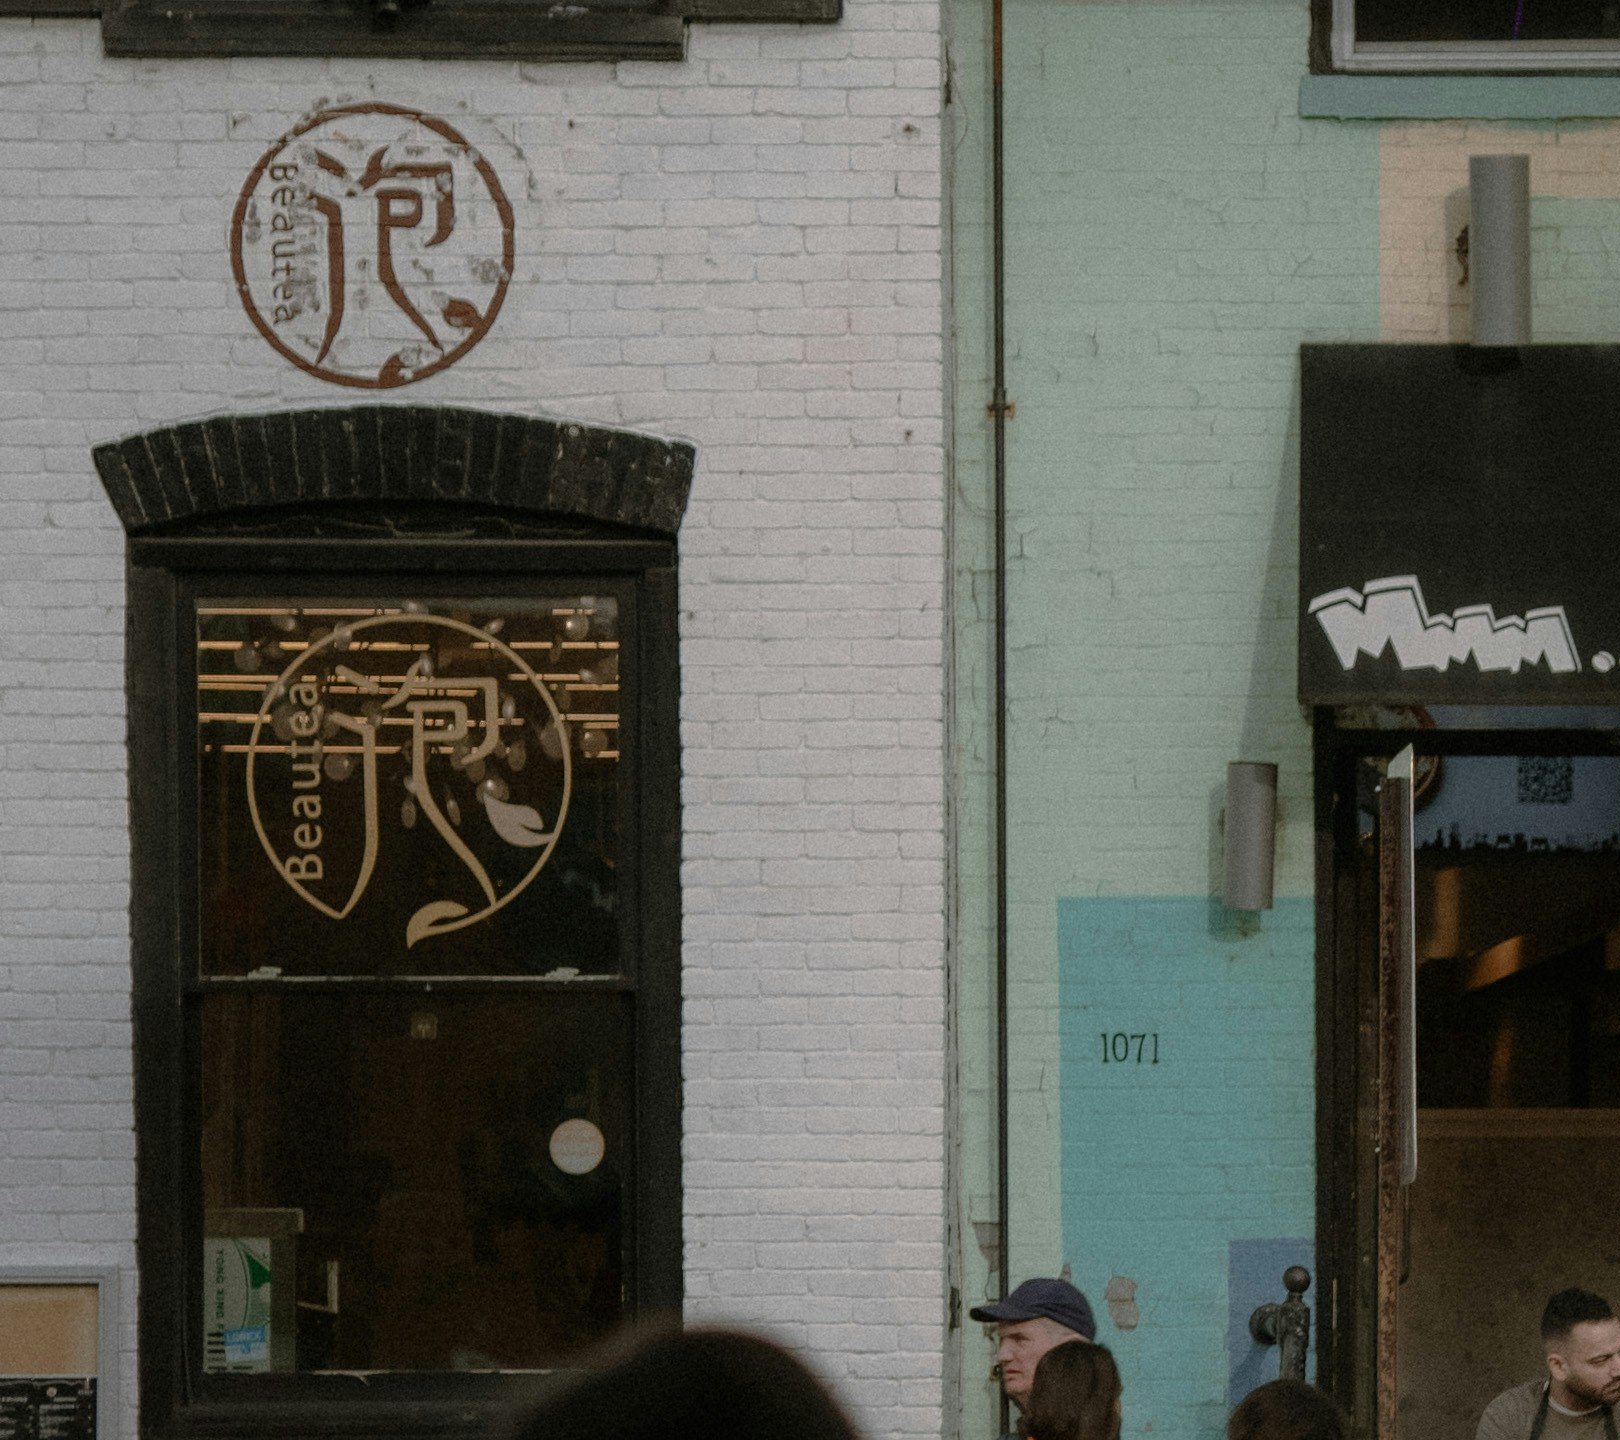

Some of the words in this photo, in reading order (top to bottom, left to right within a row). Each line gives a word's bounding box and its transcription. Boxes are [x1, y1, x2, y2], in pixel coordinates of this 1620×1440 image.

[269, 163, 299, 325] Beautea
[285, 681, 324, 881] Beautea
[1101, 1032, 1159, 1064] 1071
